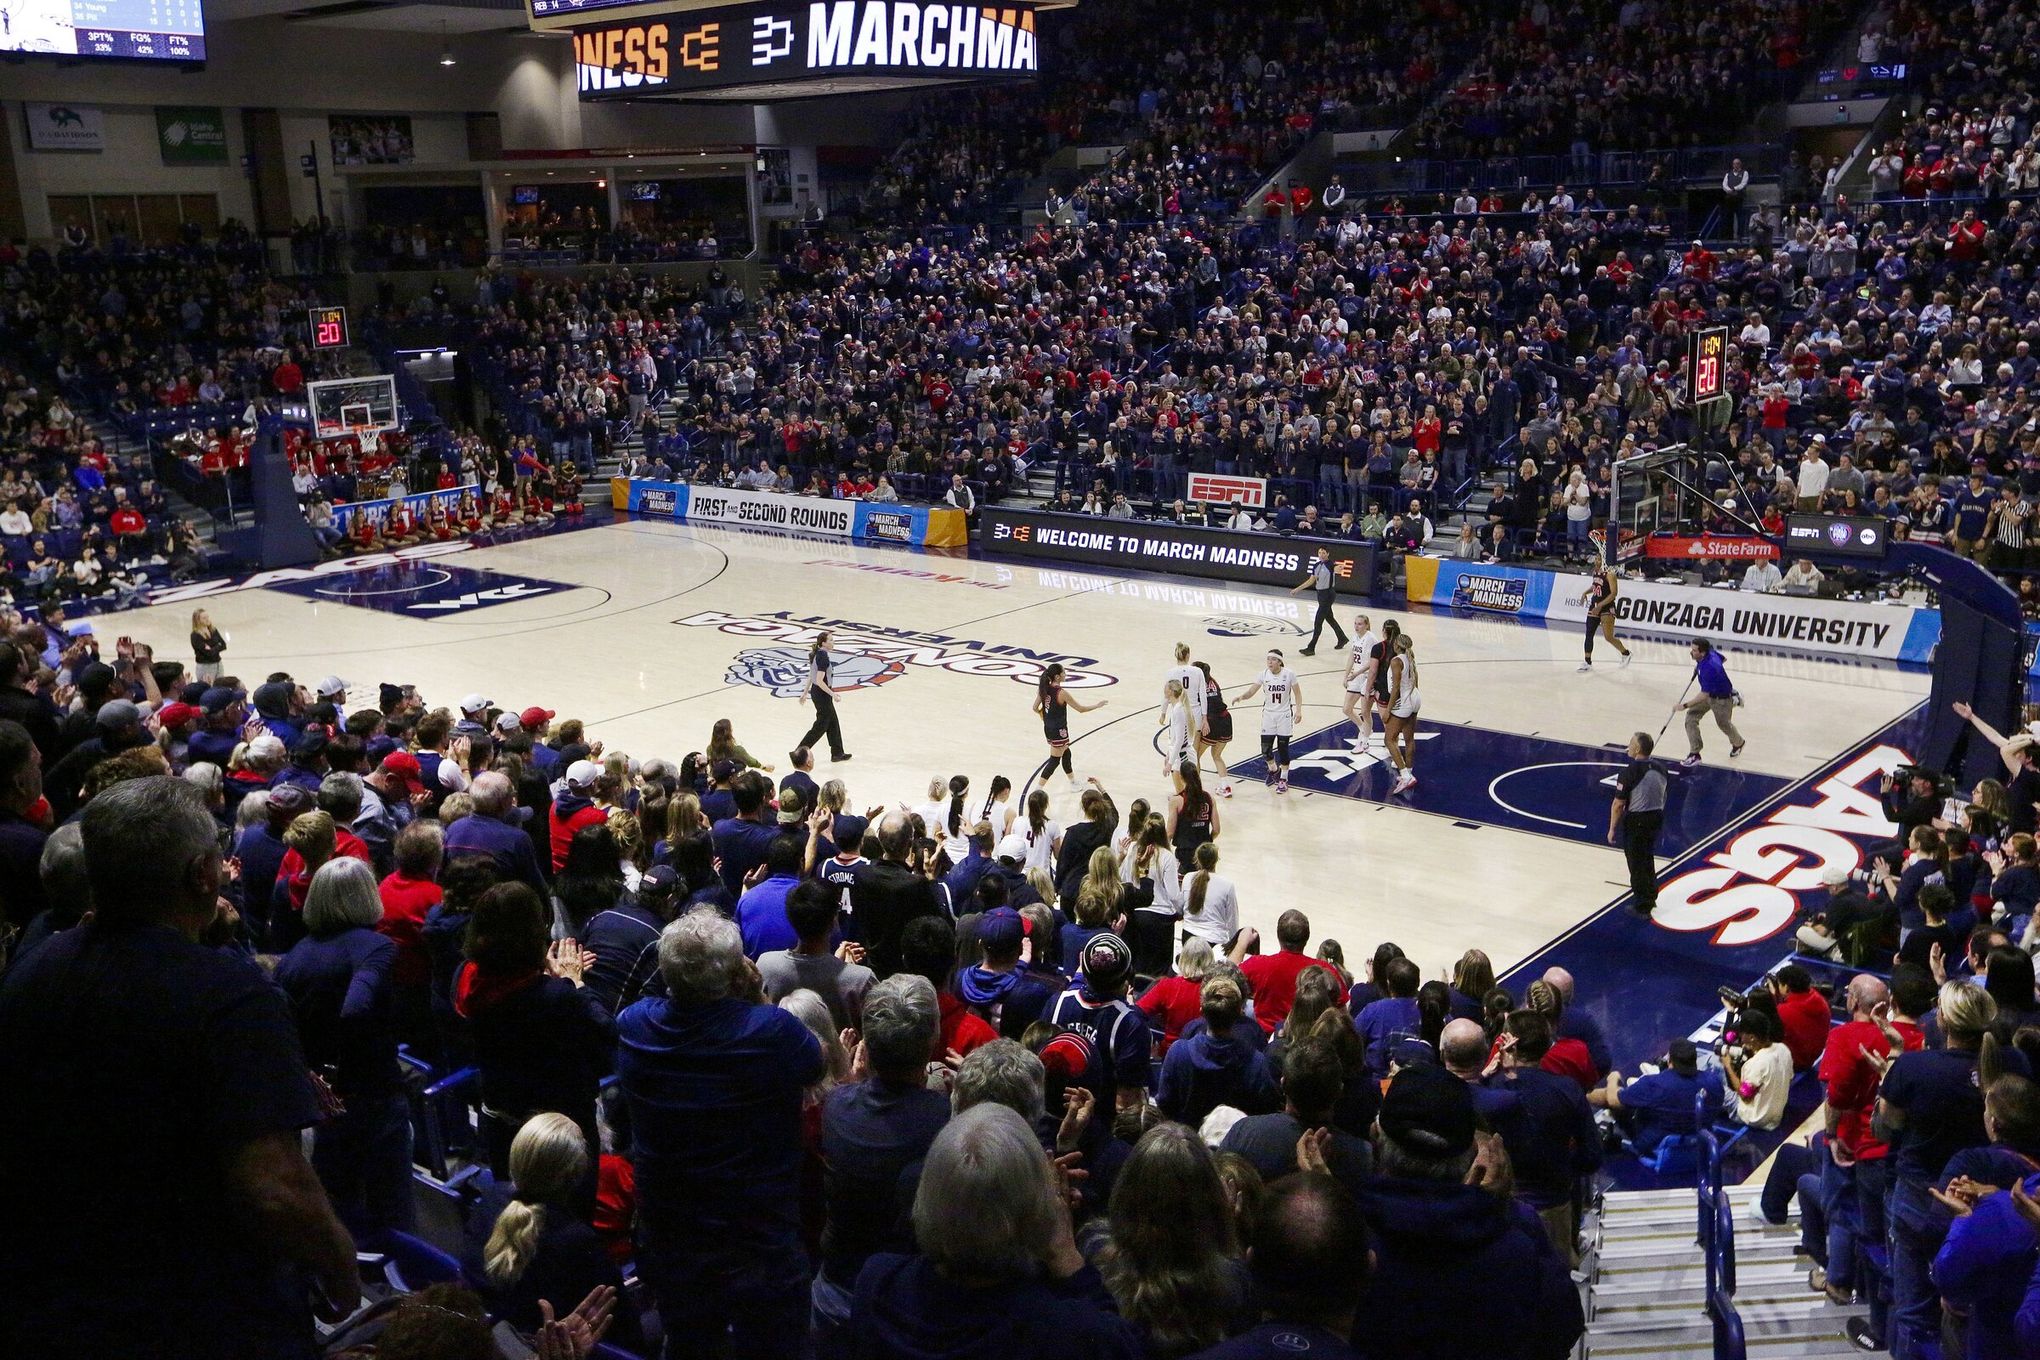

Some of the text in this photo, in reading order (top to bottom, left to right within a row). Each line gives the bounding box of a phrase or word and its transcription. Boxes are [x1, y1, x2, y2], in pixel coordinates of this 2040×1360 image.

[534, 0, 559, 11] REB 14
[87, 32, 189, 46] 3PT% FG% FT%
[807, 0, 1037, 71] MARCHMA
[95, 43, 190, 56] 33% 42% 100%
[191, 131, 225, 140] Central
[318, 323, 340, 344] 20
[1705, 336, 1721, 355] 1:04
[1698, 357, 1717, 393] 20
[647, 490, 666, 501] MARCH
[1191, 477, 1262, 504] ESPN
[650, 499, 675, 511] MADNESS
[694, 497, 728, 517] FIRST
[738, 501, 787, 523] SECOND
[790, 507, 848, 531] ROUNDS
[875, 514, 900, 526] MARCH
[878, 524, 911, 537] MADNESS
[1791, 527, 1820, 538] ESPN
[1036, 527, 1300, 572] WELCOME TO MARCH MADNESS
[1470, 577, 1505, 593] MARCH
[1472, 590, 1523, 608] MADNESS
[1615, 597, 1725, 632] GONZAGA
[1732, 609, 1891, 649] UNIVERSITY
[759, 610, 1099, 668] UNIVERSITY
[671, 610, 1121, 688] GONZAGA
[1182, 676, 1190, 690] 0
[1268, 684, 1286, 693] ZAGS
[1272, 693, 1282, 704] 14
[839, 887, 853, 915] 4
